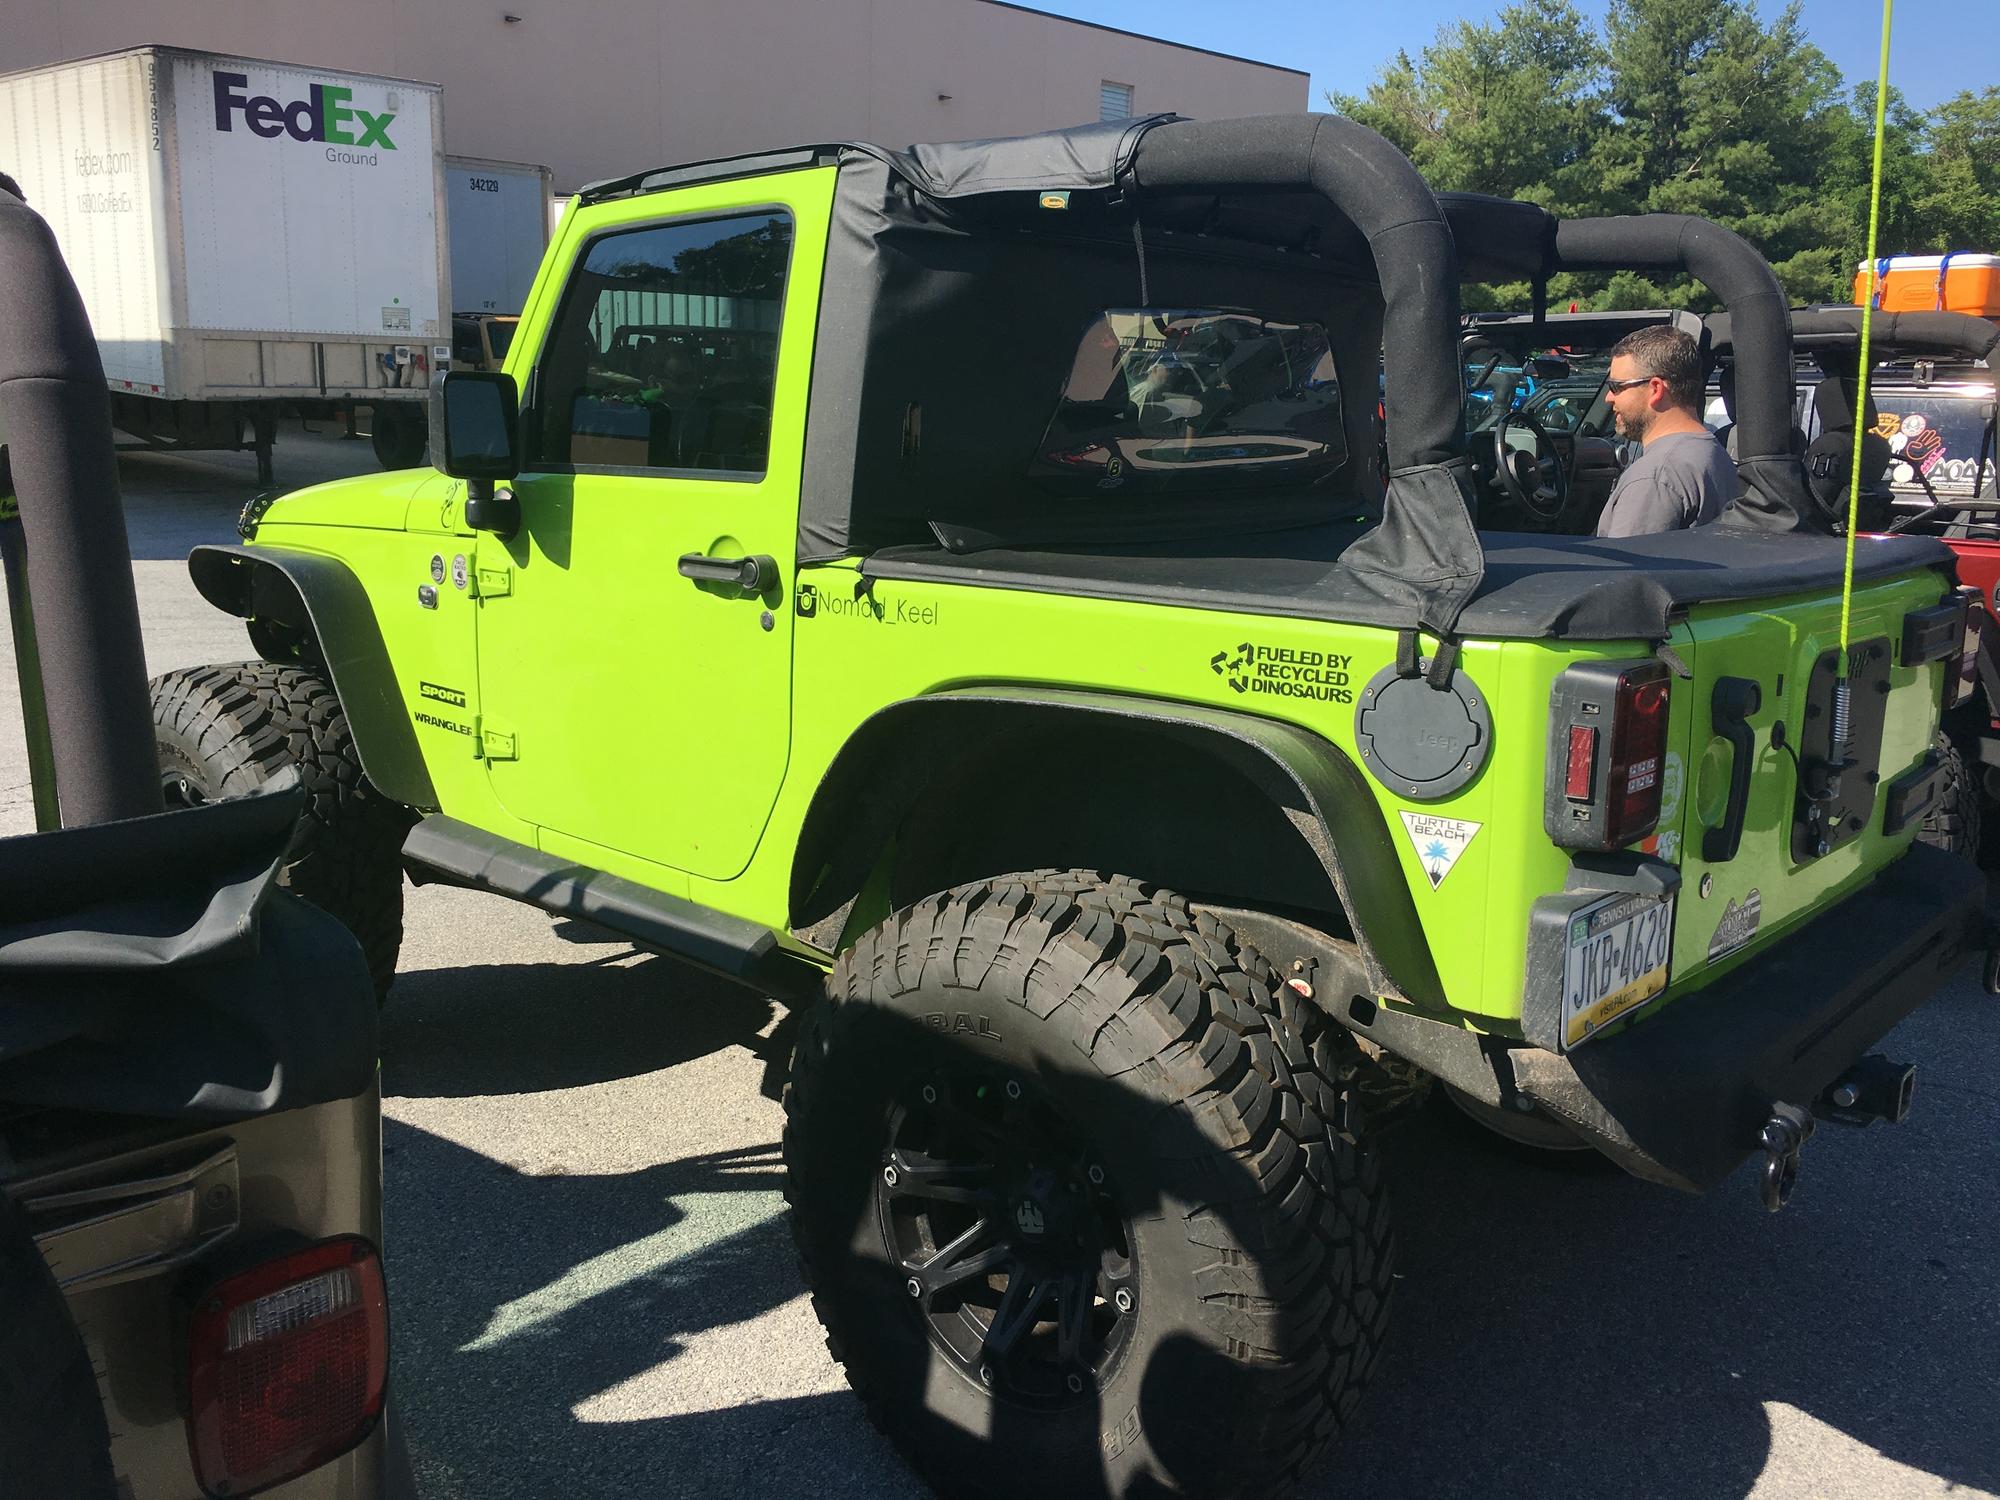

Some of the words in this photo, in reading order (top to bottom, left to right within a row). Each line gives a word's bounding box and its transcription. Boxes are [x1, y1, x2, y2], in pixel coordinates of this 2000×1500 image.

[212, 70, 398, 150] FedEx
[75, 148, 132, 177] fedex.com
[325, 147, 378, 166] Ground
[470, 177, 499, 193] 342129
[1256, 645, 1324, 667] FUELED
[1326, 653, 1353, 671] BY
[1257, 662, 1350, 687] RECYCLED
[421, 684, 464, 705] SPORT
[1251, 677, 1354, 704] DINOSAURS
[414, 711, 473, 736] WRANGLER
[1415, 728, 1461, 752] Jeep
[1407, 814, 1466, 832] TURTLE
[1414, 825, 1466, 843] BEACH
